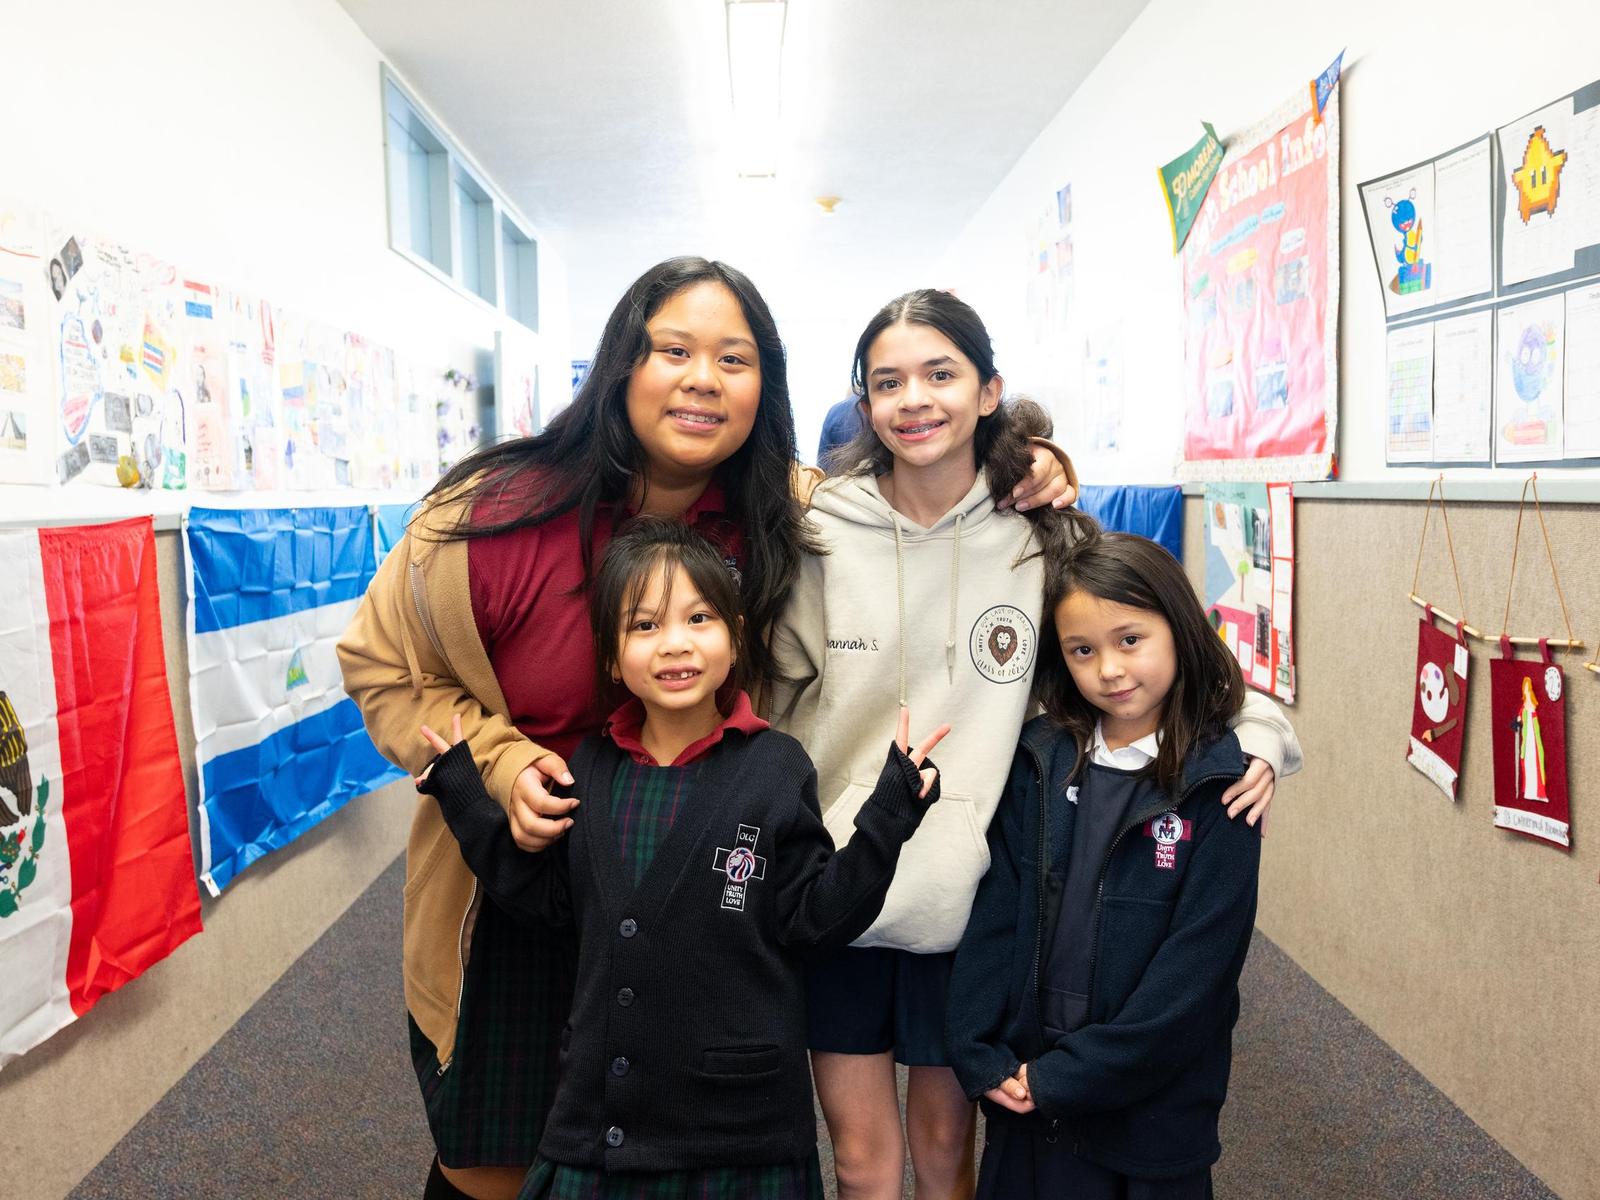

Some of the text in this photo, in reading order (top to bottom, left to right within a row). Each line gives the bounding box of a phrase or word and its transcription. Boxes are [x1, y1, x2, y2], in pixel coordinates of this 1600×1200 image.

[1219, 142, 1277, 213] School
[1281, 115, 1327, 177] Info
[1020, 639, 1028, 656] LOVE
[977, 659, 995, 675] CLASS
[739, 832, 755, 842] OLG
[1157, 844, 1175, 852] UNITY
[1156, 852, 1174, 860] TRUTH
[1157, 860, 1173, 868] LOVE
[728, 885, 743, 893] UNITY
[726, 891, 743, 899] TRUTH
[726, 897, 742, 905] LOVE
